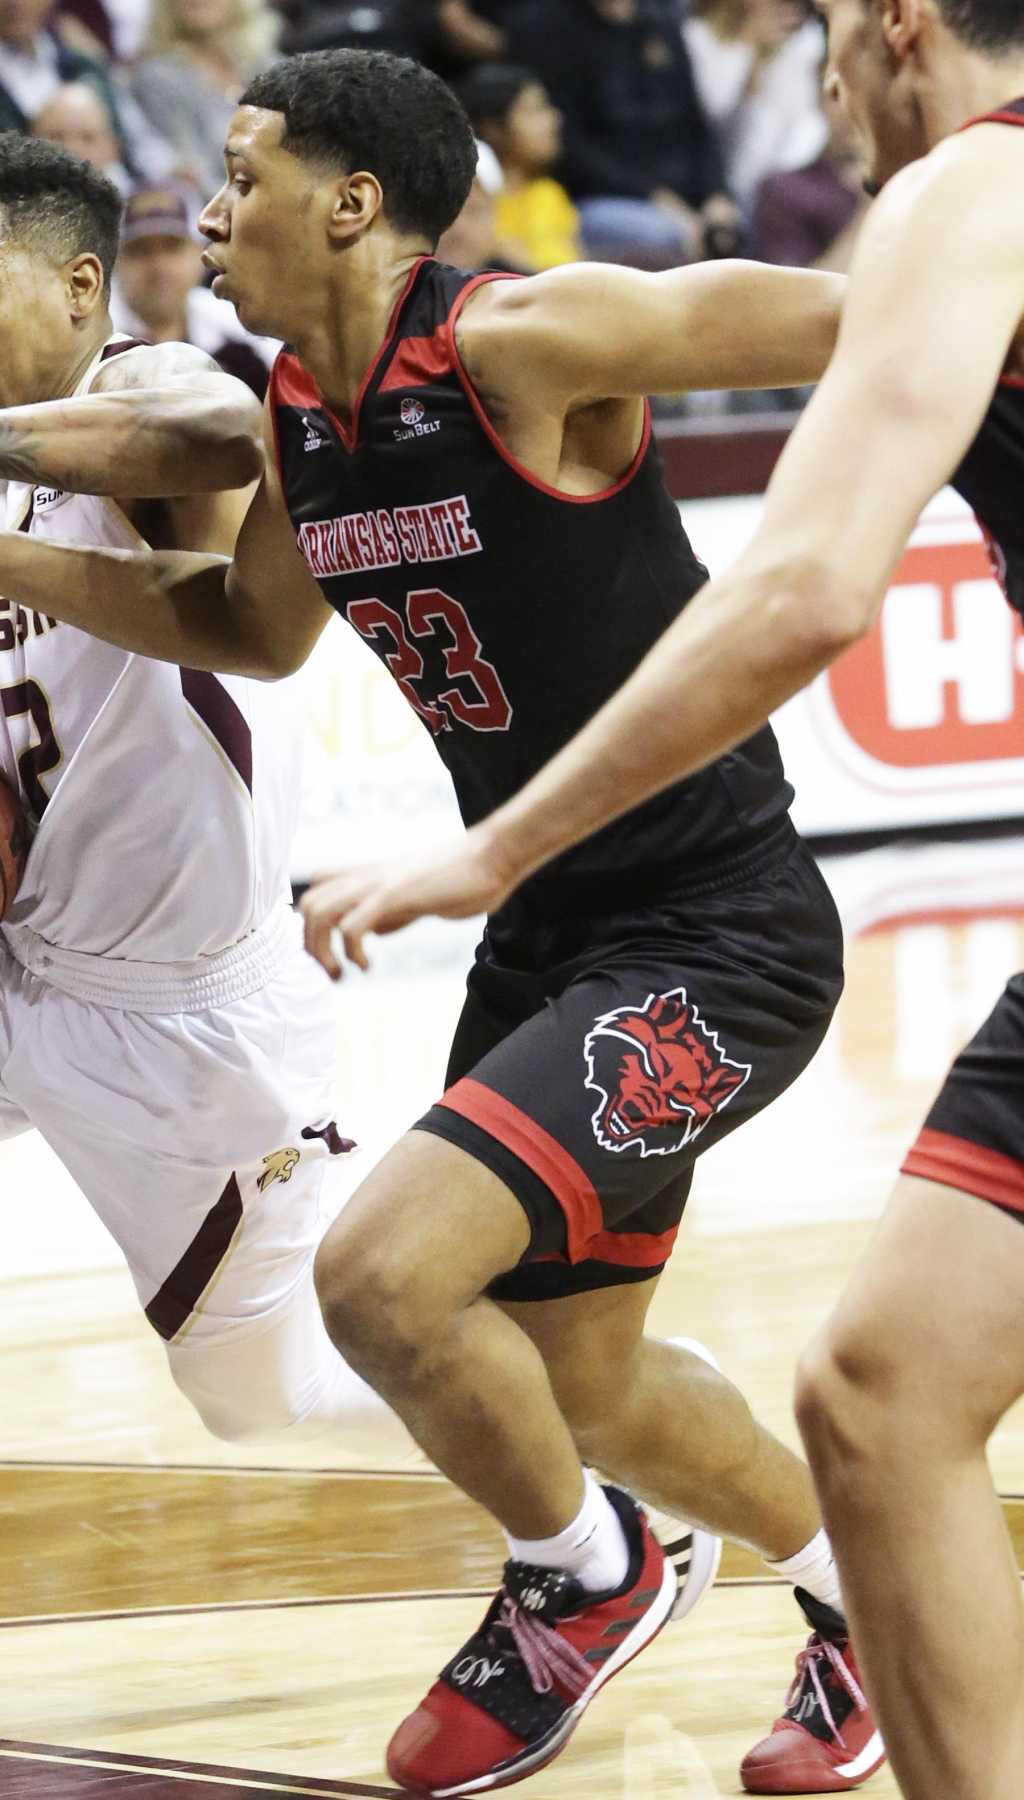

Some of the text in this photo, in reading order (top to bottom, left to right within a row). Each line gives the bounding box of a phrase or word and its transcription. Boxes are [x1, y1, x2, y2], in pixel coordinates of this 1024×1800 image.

[414, 420, 440, 436] BELT
[297, 494, 483, 578] RKANSAS STATE
[347, 588, 513, 735] 23
[880, 576, 1024, 731] H
